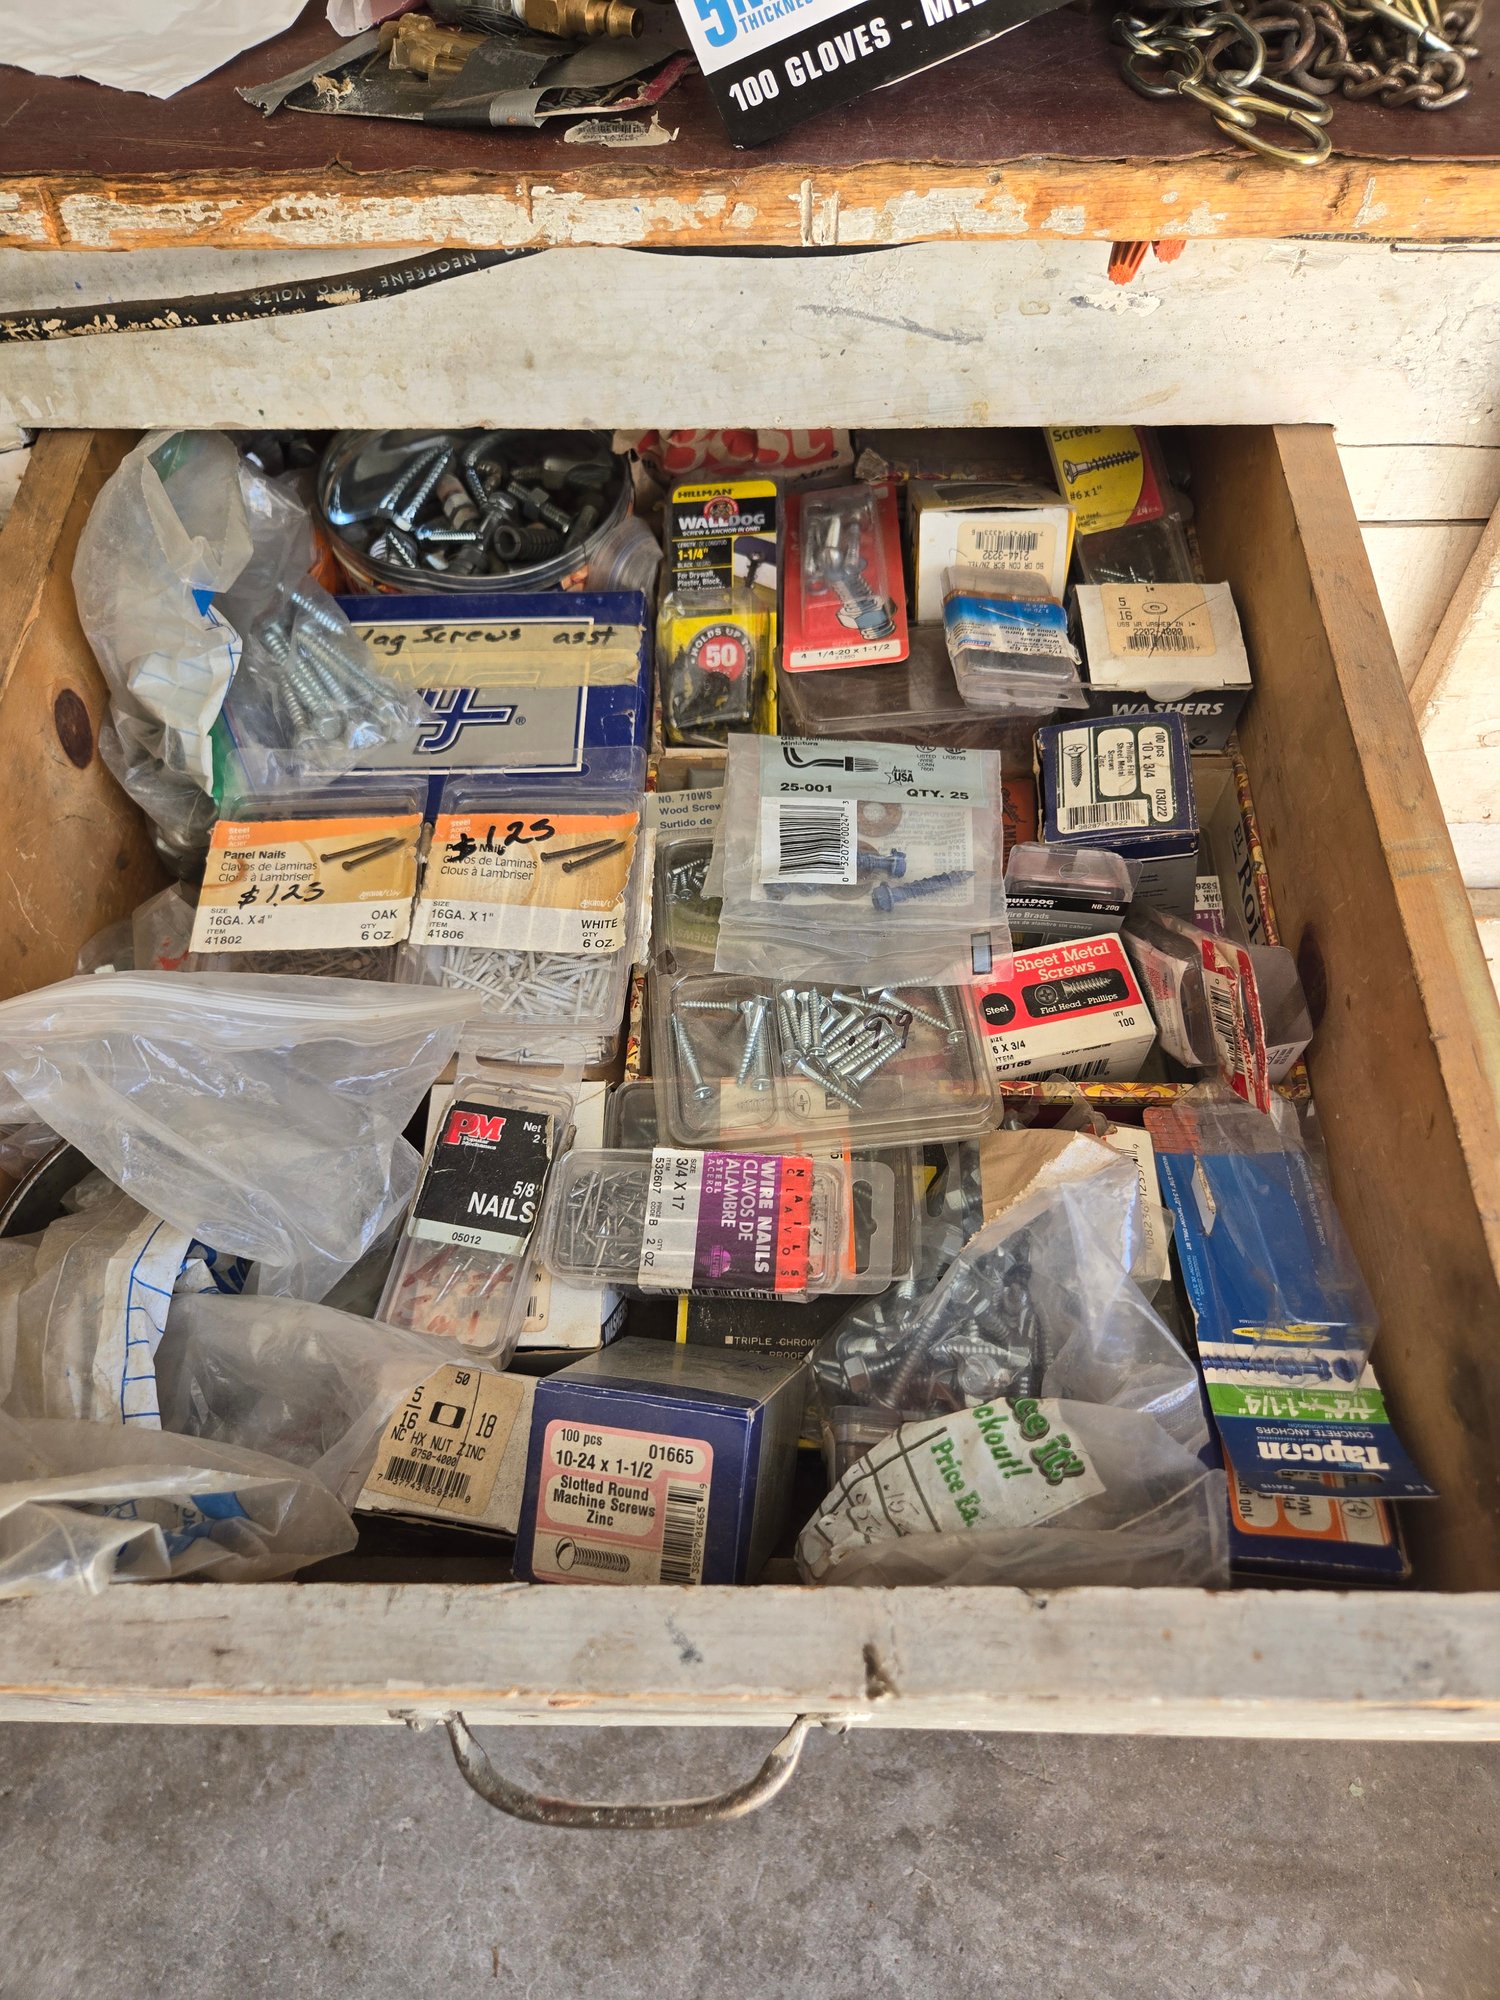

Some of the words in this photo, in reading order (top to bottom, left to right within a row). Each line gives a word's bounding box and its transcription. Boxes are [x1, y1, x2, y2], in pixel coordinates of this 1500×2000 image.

[728, 69, 780, 112] 100
[785, 17, 892, 88] GLOVES
[381, 252, 478, 289] NEOPRENE
[1052, 427, 1102, 442] Screws
[677, 488, 733, 498] HILLMAN
[678, 514, 765, 531] WALLDOG
[677, 548, 709, 561] 1-1/4"
[982, 550, 1029, 561] 2144-3232
[677, 571, 687, 580] For
[689, 570, 715, 581] Drywall,
[677, 578, 701, 587] Plaster,
[702, 577, 723, 587] Block,
[1120, 611, 1132, 620] 16
[413, 626, 521, 646] Screws
[554, 627, 617, 646] asst
[706, 644, 738, 668] 50
[818, 648, 851, 659] 1/4-20
[863, 643, 890, 653] 1-1/2
[1112, 703, 1224, 716] WASHERS
[1142, 741, 1154, 752] 10
[1155, 732, 1165, 745] 100
[1126, 741, 1134, 764] Phillips
[1156, 746, 1165, 758] pcs
[1098, 754, 1106, 768] Zinc
[1118, 761, 1126, 777] Metal
[894, 772, 914, 783] USA
[1144, 763, 1155, 778] 3/4
[658, 795, 675, 804] NO.
[680, 791, 713, 801] 710WS
[780, 783, 832, 793] 25-001
[907, 789, 944, 798] QTY.
[950, 791, 969, 800] 25
[659, 805, 689, 816] Wood
[1155, 788, 1168, 818] 03022
[228, 827, 250, 835] Steel
[451, 819, 470, 828] Steel
[660, 818, 696, 829] Surtido
[223, 851, 255, 859] Panel
[258, 850, 286, 859] Nails
[479, 843, 506, 854] Nails
[220, 862, 255, 872] Clavos
[257, 861, 272, 871] de
[274, 861, 318, 871] Laminas
[440, 866, 469, 875] Clous
[480, 868, 534, 881] Lambriser
[218, 873, 248, 883] Clous
[260, 872, 313, 882] Lambriser
[372, 909, 398, 920] OAK
[431, 909, 465, 920] 16GA.
[469, 912, 478, 921] X
[481, 913, 494, 922] 1"
[581, 918, 618, 929] WHITE
[205, 936, 242, 945] 41802
[361, 931, 370, 940] 6
[373, 931, 394, 940] OZ.
[427, 930, 464, 939] 41806
[582, 939, 590, 948] 6
[595, 939, 615, 948] OZ.
[1014, 952, 1060, 974] Sheet
[1063, 942, 1111, 962] Metal
[1038, 961, 1096, 982] Screws
[985, 1004, 1009, 1016] Steel
[1040, 1003, 1058, 1015] Flat
[1060, 1000, 1082, 1012] Head
[1088, 993, 1118, 1008] Phillips
[1118, 1017, 1135, 1028] 100
[992, 1045, 999, 1054] 6
[1001, 1044, 1009, 1052] X
[1011, 1040, 1026, 1050] 3/4
[442, 1110, 506, 1146] PM
[523, 1121, 541, 1133] Net
[462, 1136, 489, 1145] Popular
[532, 1135, 540, 1143] 2
[652, 1157, 665, 1194] 532607
[676, 1158, 689, 1177] 3/4
[705, 1158, 715, 1194] ACERO
[714, 1158, 724, 1194] STEEL
[512, 1181, 543, 1198] 5/8"
[673, 1181, 687, 1191] X
[740, 1160, 758, 1217] CLAVOS
[759, 1160, 776, 1209] WIRE
[721, 1158, 740, 1228] ALAMBRE
[467, 1192, 536, 1223] NAILS
[672, 1195, 685, 1211] 17
[648, 1218, 659, 1226] B
[451, 1231, 482, 1245] 05012
[738, 1221, 754, 1241] DE
[754, 1216, 772, 1273] NAILS
[644, 1251, 655, 1267] OZ
[734, 1336, 772, 1346] TRIPLE
[455, 1371, 471, 1386] 50
[1238, 1395, 1300, 1418] 1-1/4"
[400, 1410, 419, 1430] 16
[475, 1412, 498, 1439] 18
[1255, 1426, 1313, 1438] ANCHORS
[1315, 1429, 1374, 1439] CONCRETE
[390, 1426, 407, 1441] NC
[411, 1431, 427, 1446] HX
[430, 1435, 453, 1452] NUT
[456, 1442, 486, 1461] ZINC
[561, 1428, 580, 1443] 100
[583, 1432, 603, 1446] pcs
[649, 1444, 694, 1465] 01665
[411, 1447, 459, 1467] 0750-4000
[1030, 1433, 1085, 1486] it!
[1257, 1439, 1390, 1472] Tapcon
[556, 1450, 596, 1470] 10-24
[600, 1461, 609, 1472] x
[616, 1460, 653, 1479] 1-1/2
[930, 1437, 966, 1493] Price
[560, 1475, 603, 1494] Slotted
[608, 1483, 649, 1501] Round
[553, 1489, 605, 1510] Machine
[610, 1498, 656, 1518] Screws
[586, 1509, 614, 1527] Zinc
